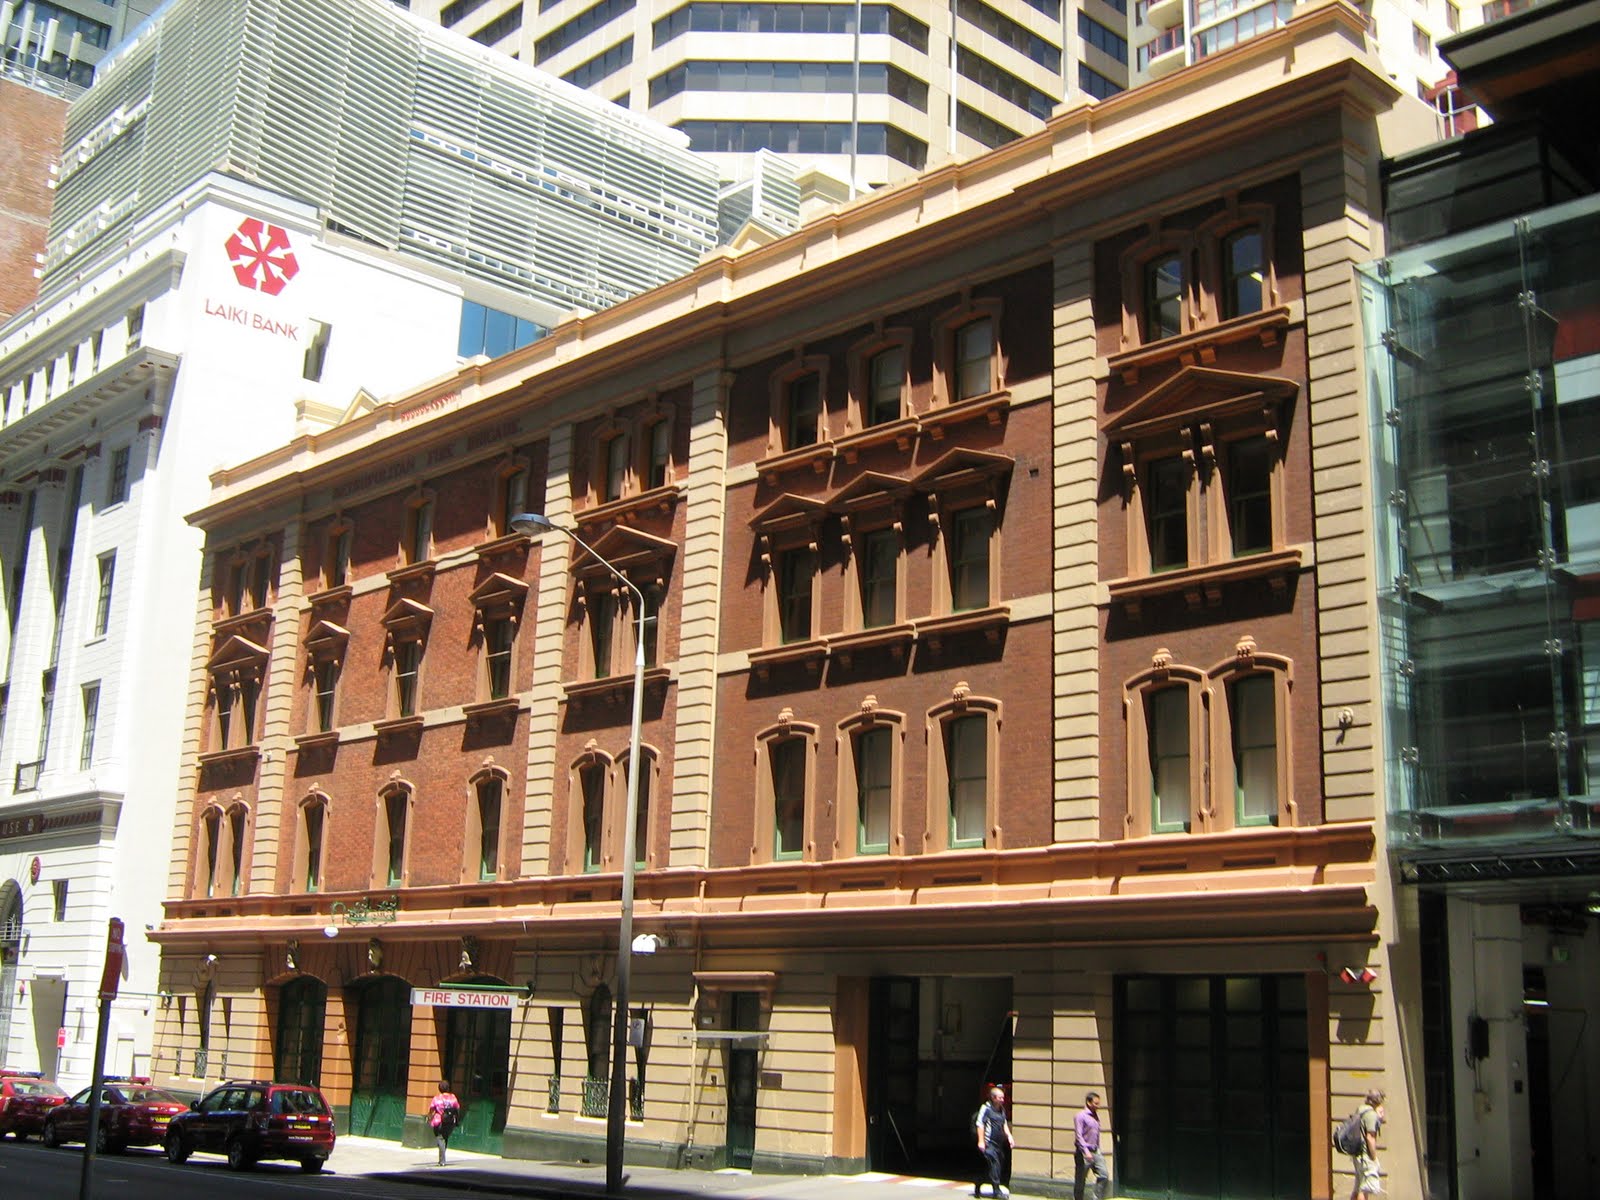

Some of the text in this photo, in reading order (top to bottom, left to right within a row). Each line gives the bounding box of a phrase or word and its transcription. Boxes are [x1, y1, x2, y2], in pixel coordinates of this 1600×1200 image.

[205, 298, 298, 341] LAIKI BANK
[423, 991, 510, 1006] FIRE STATION
